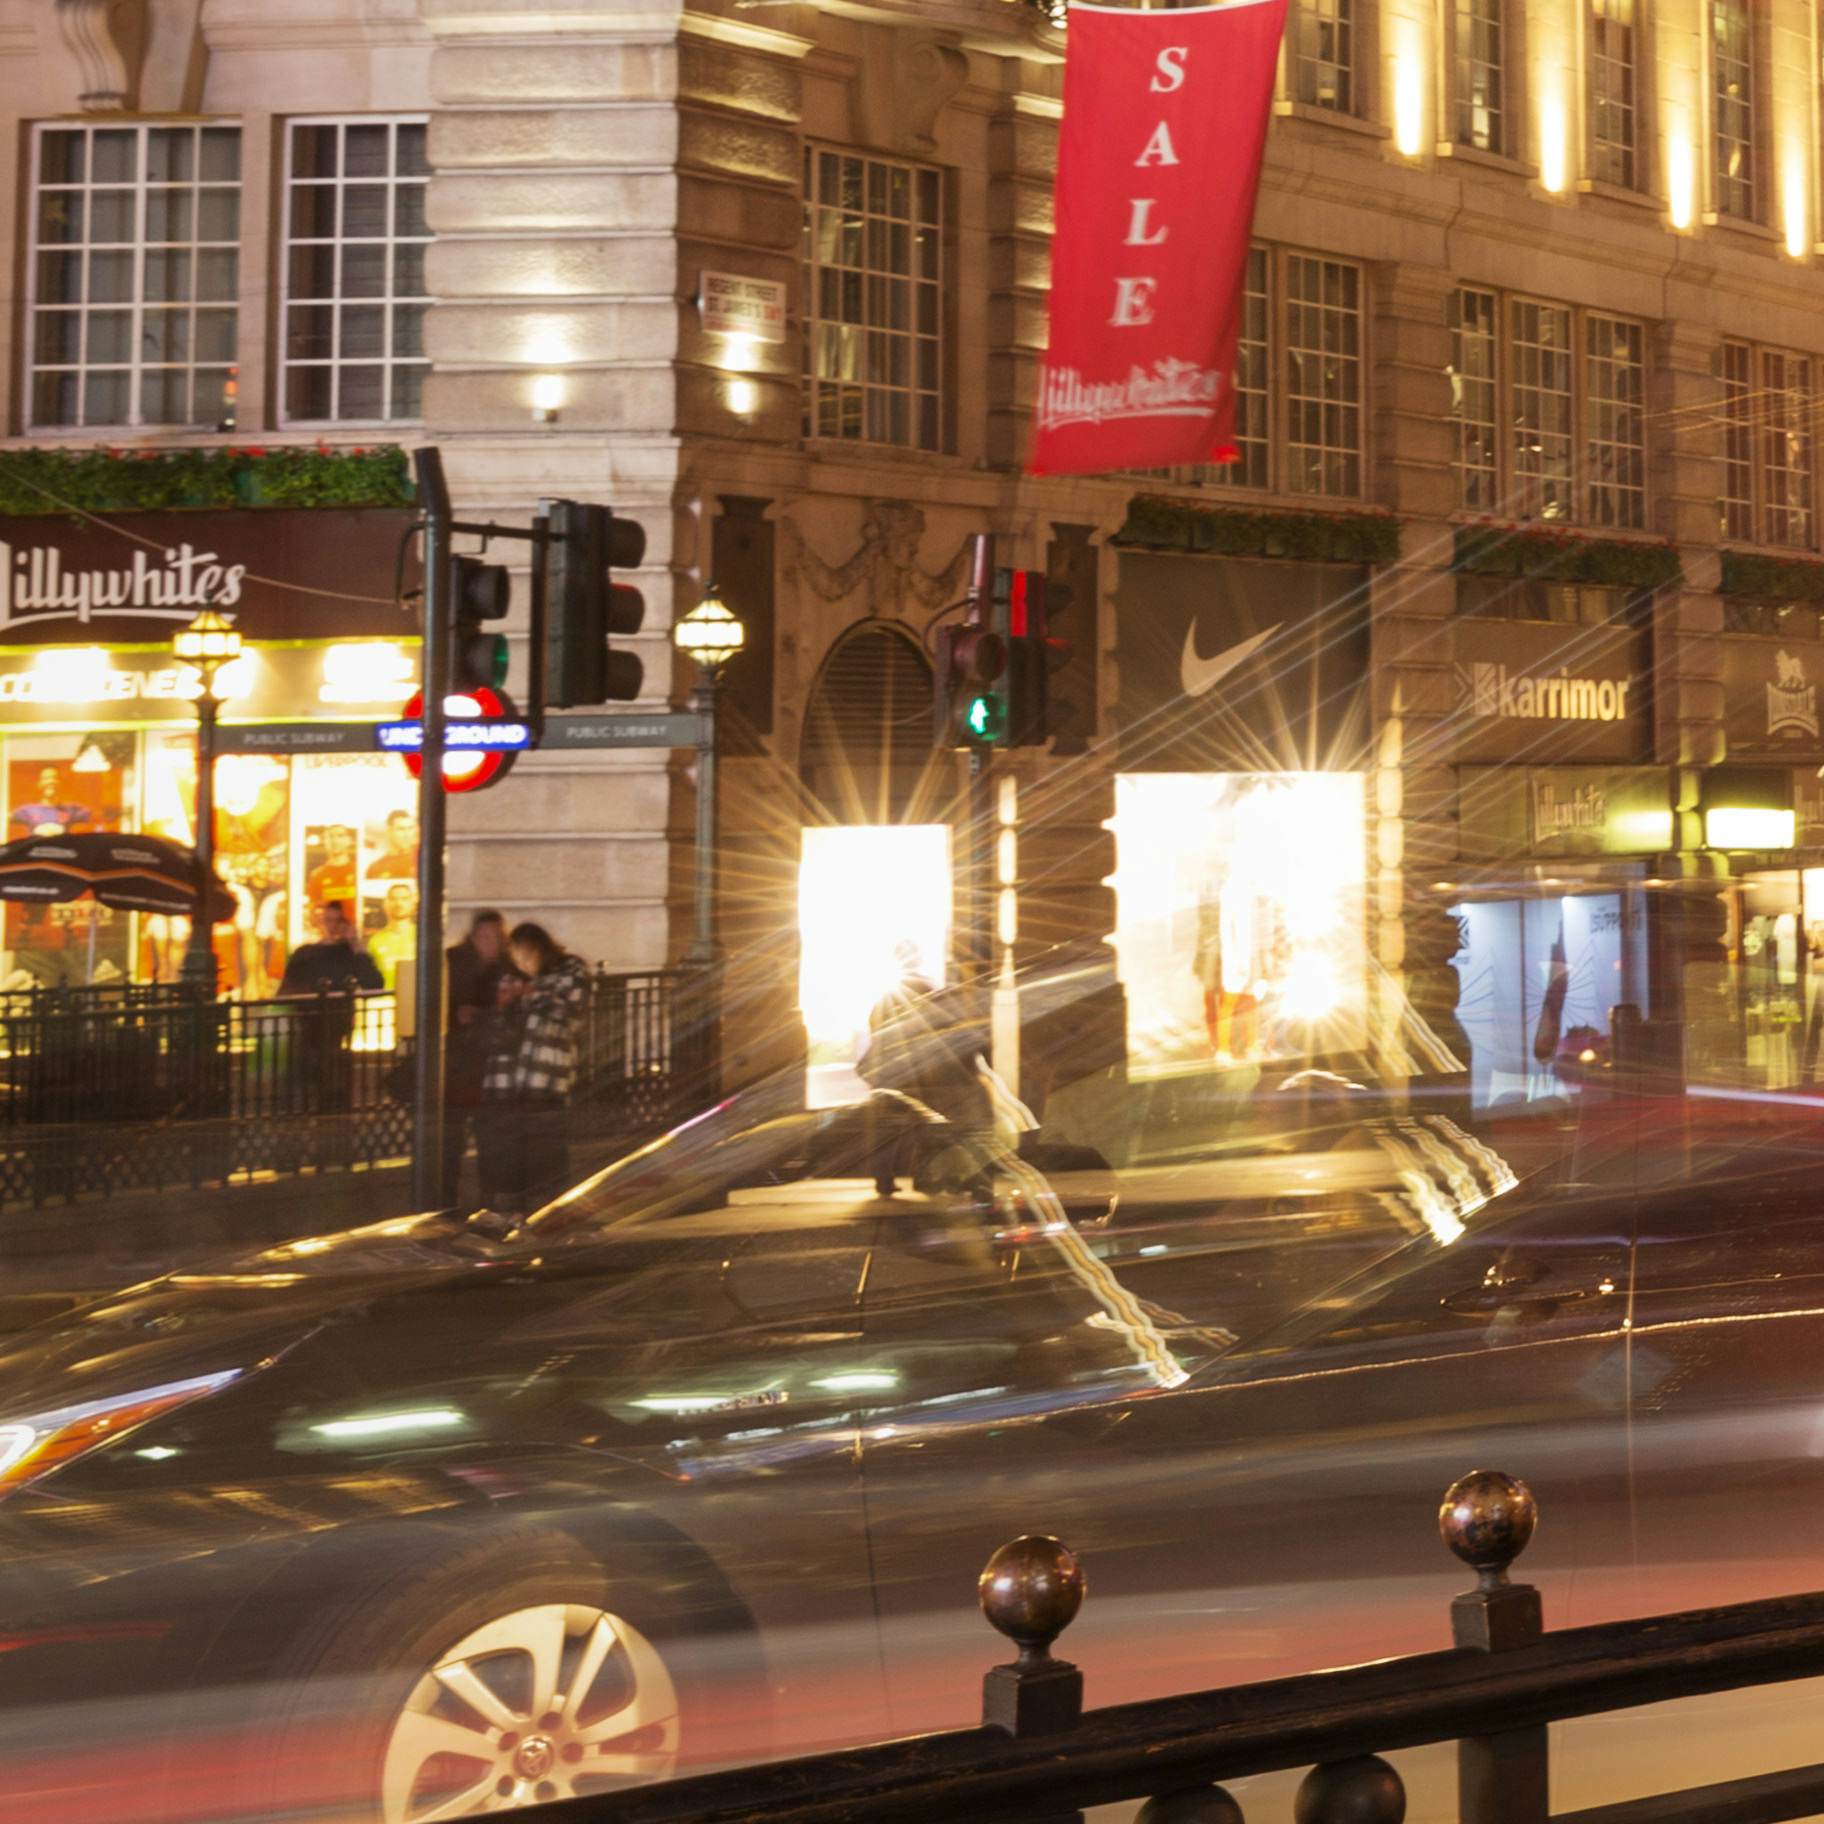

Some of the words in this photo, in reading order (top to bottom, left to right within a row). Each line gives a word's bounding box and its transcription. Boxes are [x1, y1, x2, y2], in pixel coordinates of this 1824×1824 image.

[1110, 46, 1188, 328] SALE
[1500, 664, 1629, 722] karrimor
[243, 732, 289, 745] PUBLIC
[291, 732, 345, 745] SUBWAY
[380, 725, 526, 747] UNDGROUND
[566, 726, 609, 739] PUBLIC
[613, 725, 667, 738] SUBWAY
